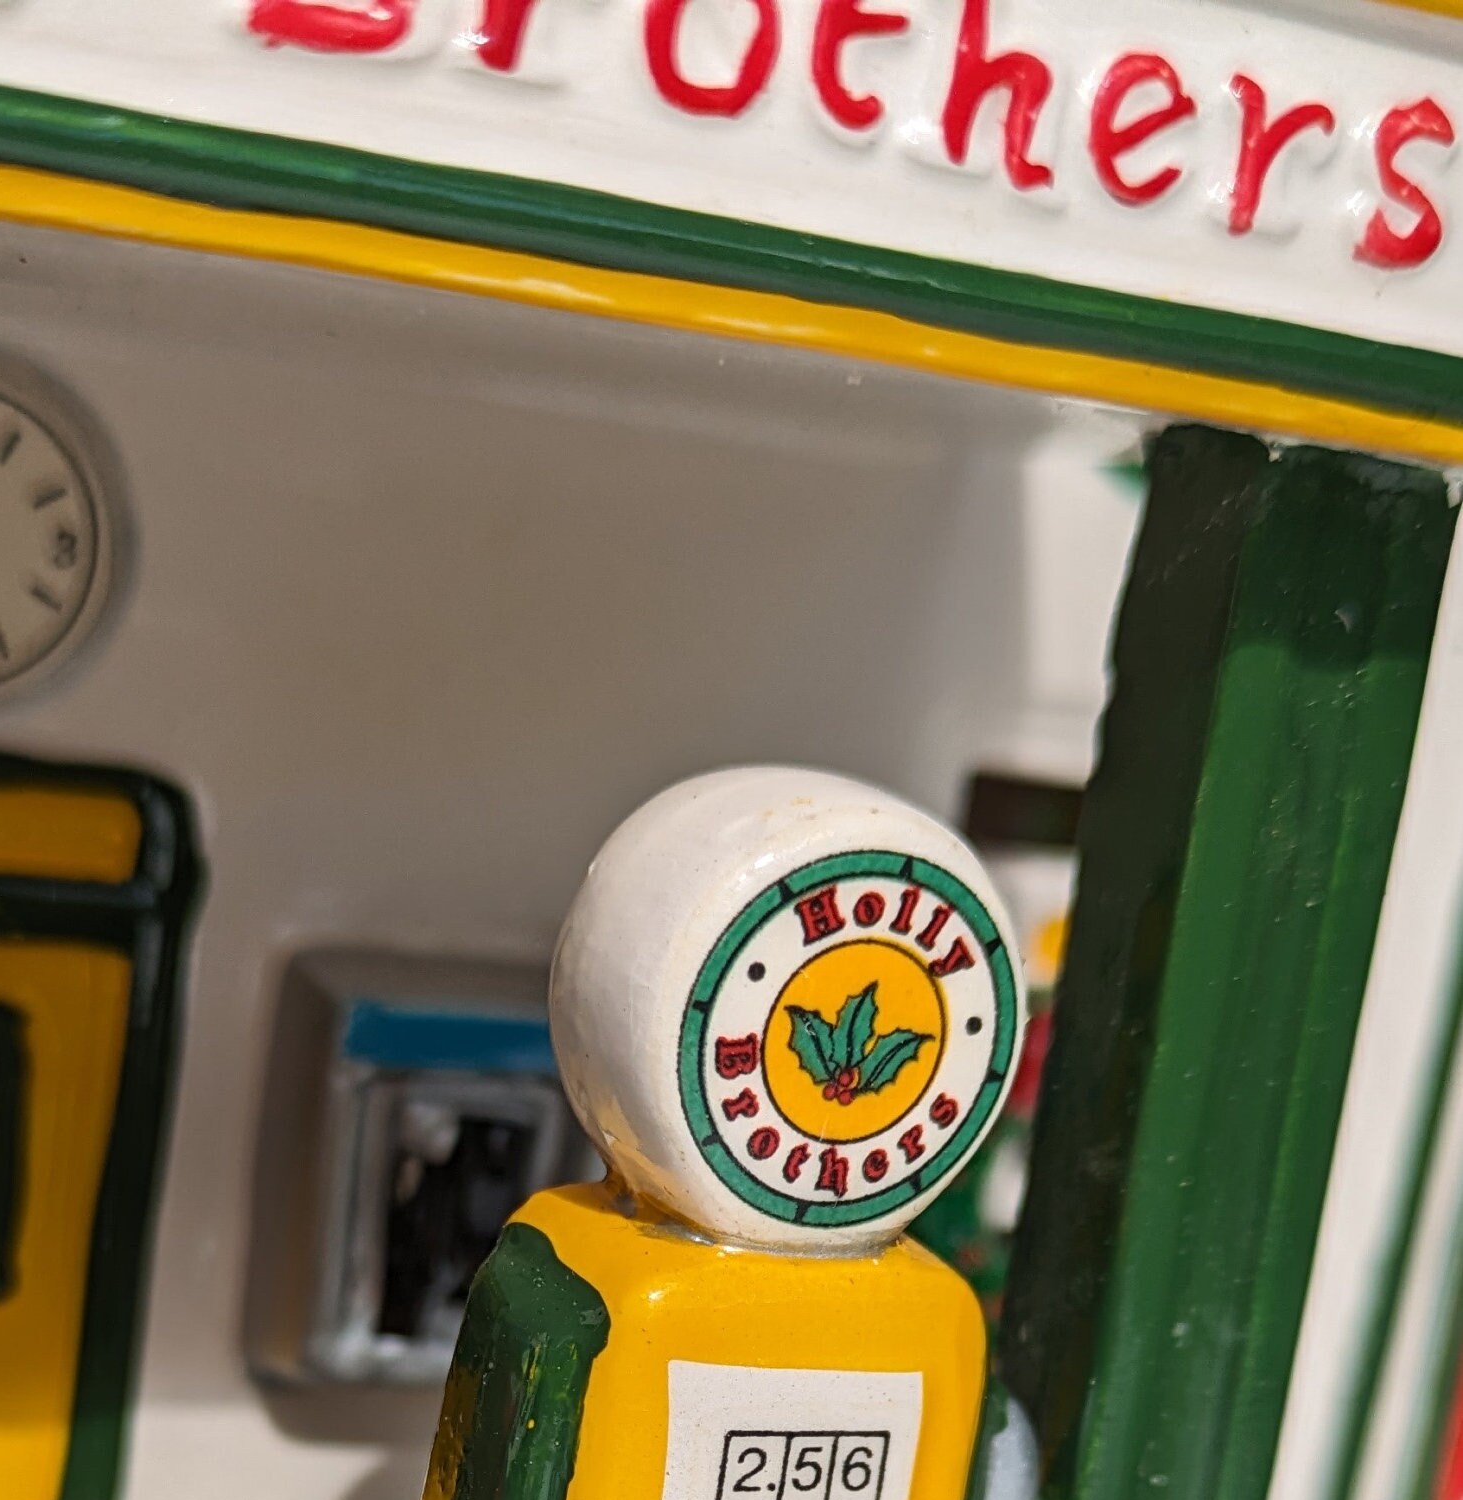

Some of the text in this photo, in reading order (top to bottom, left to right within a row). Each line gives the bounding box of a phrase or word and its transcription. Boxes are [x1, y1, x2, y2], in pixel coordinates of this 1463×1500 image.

[247, 0, 1456, 269] others
[794, 884, 976, 977] Holly
[714, 1032, 959, 1198] Brothers
[732, 1446, 873, 1492] 2.56
